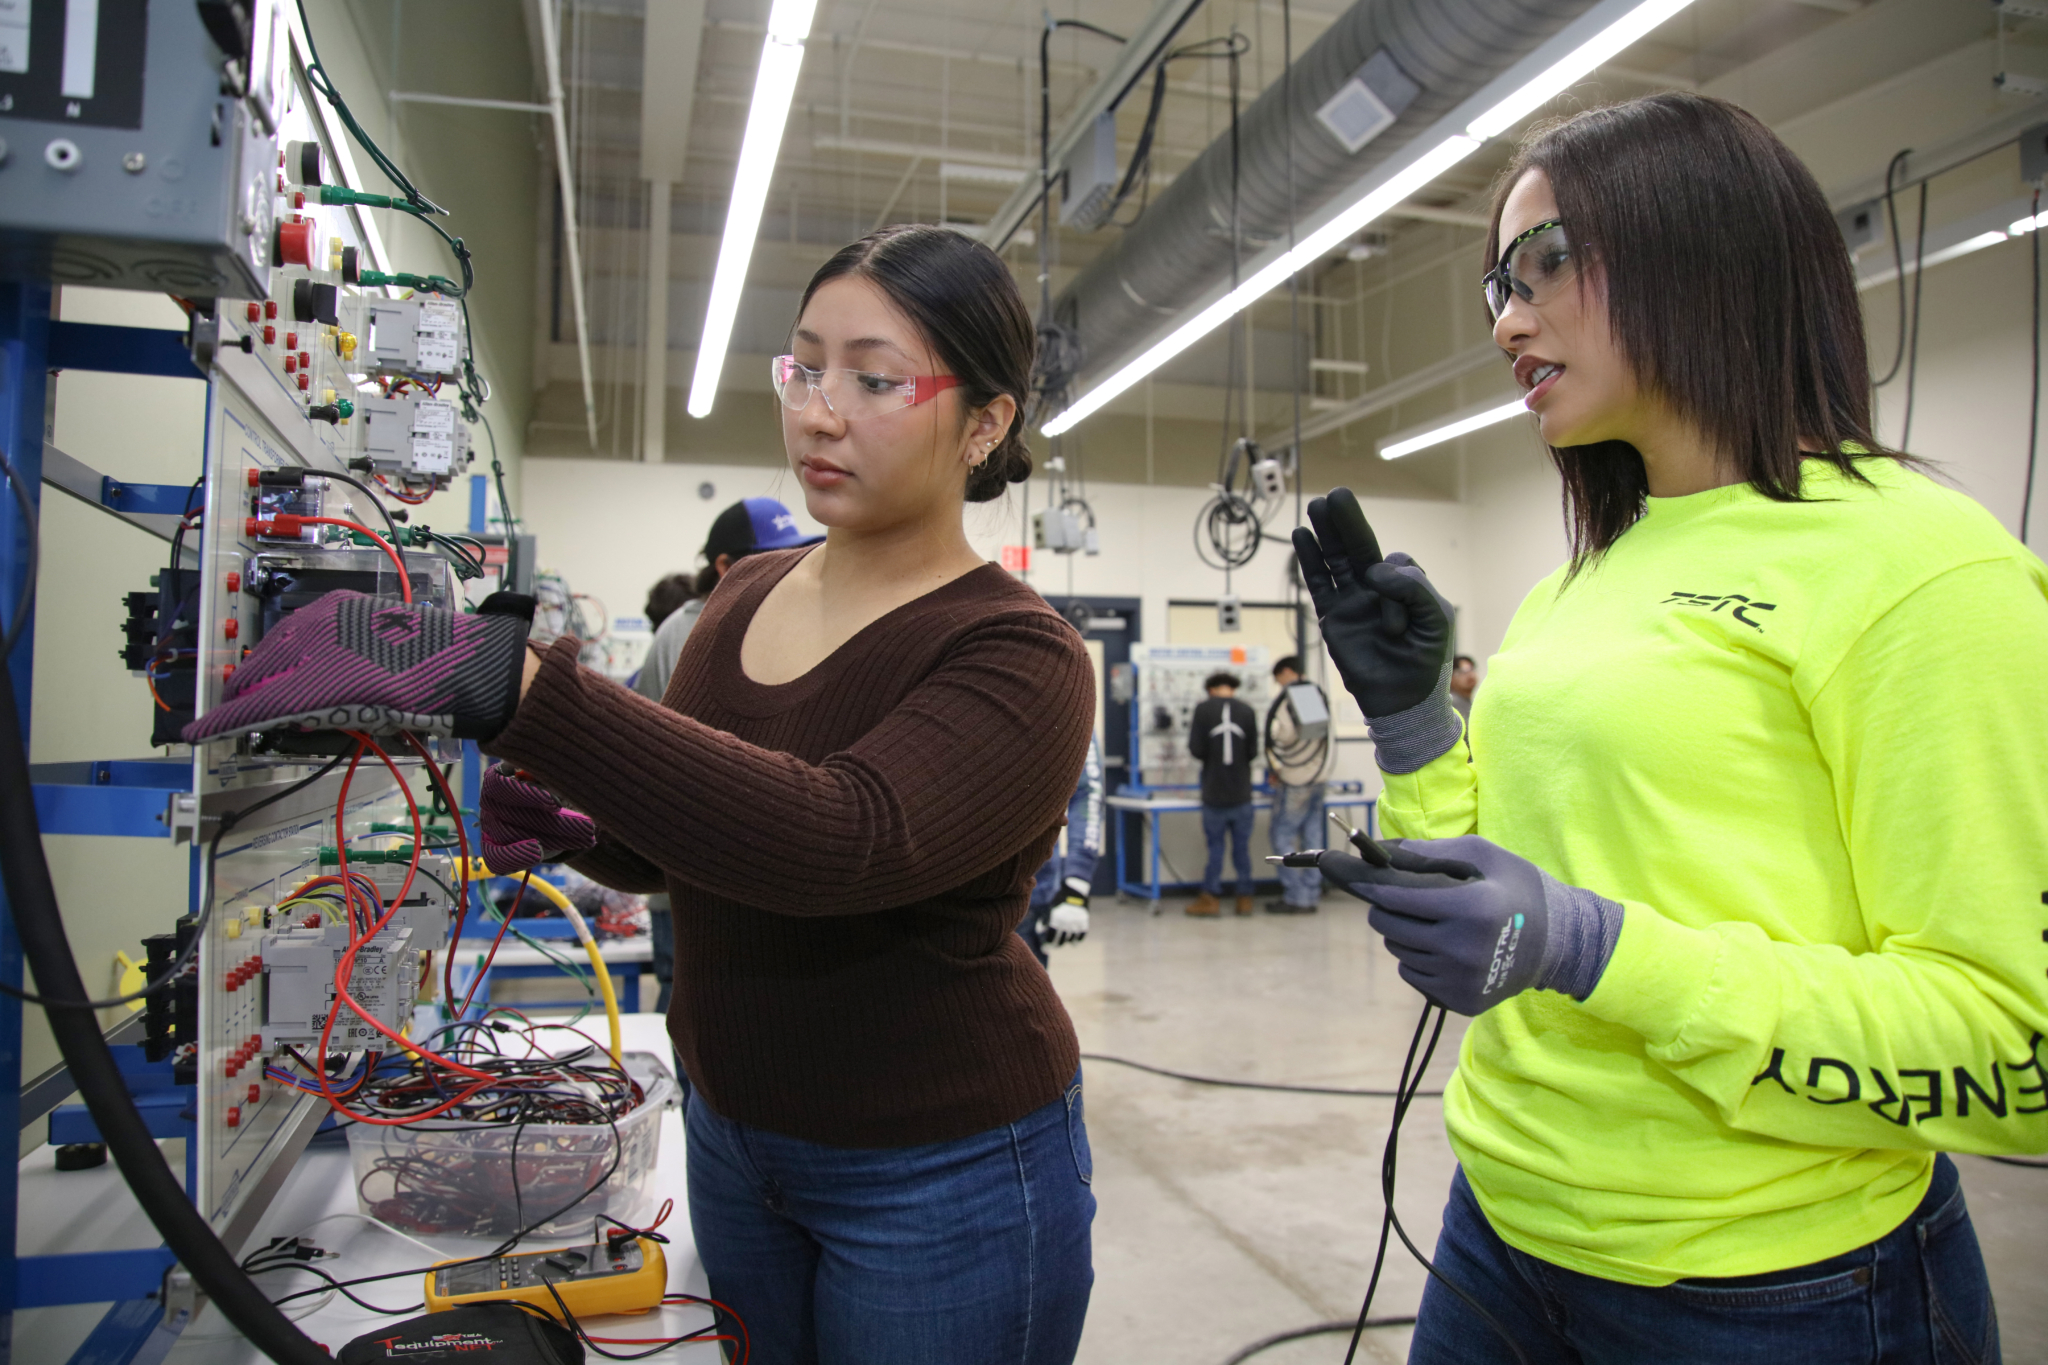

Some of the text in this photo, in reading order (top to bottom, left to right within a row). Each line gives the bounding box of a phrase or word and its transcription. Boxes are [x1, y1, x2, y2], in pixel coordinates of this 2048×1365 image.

[1659, 591, 1777, 628] TSTC
[342, 945, 384, 954] Al-Bradley
[1751, 1046, 2048, 1127] ENERGY
